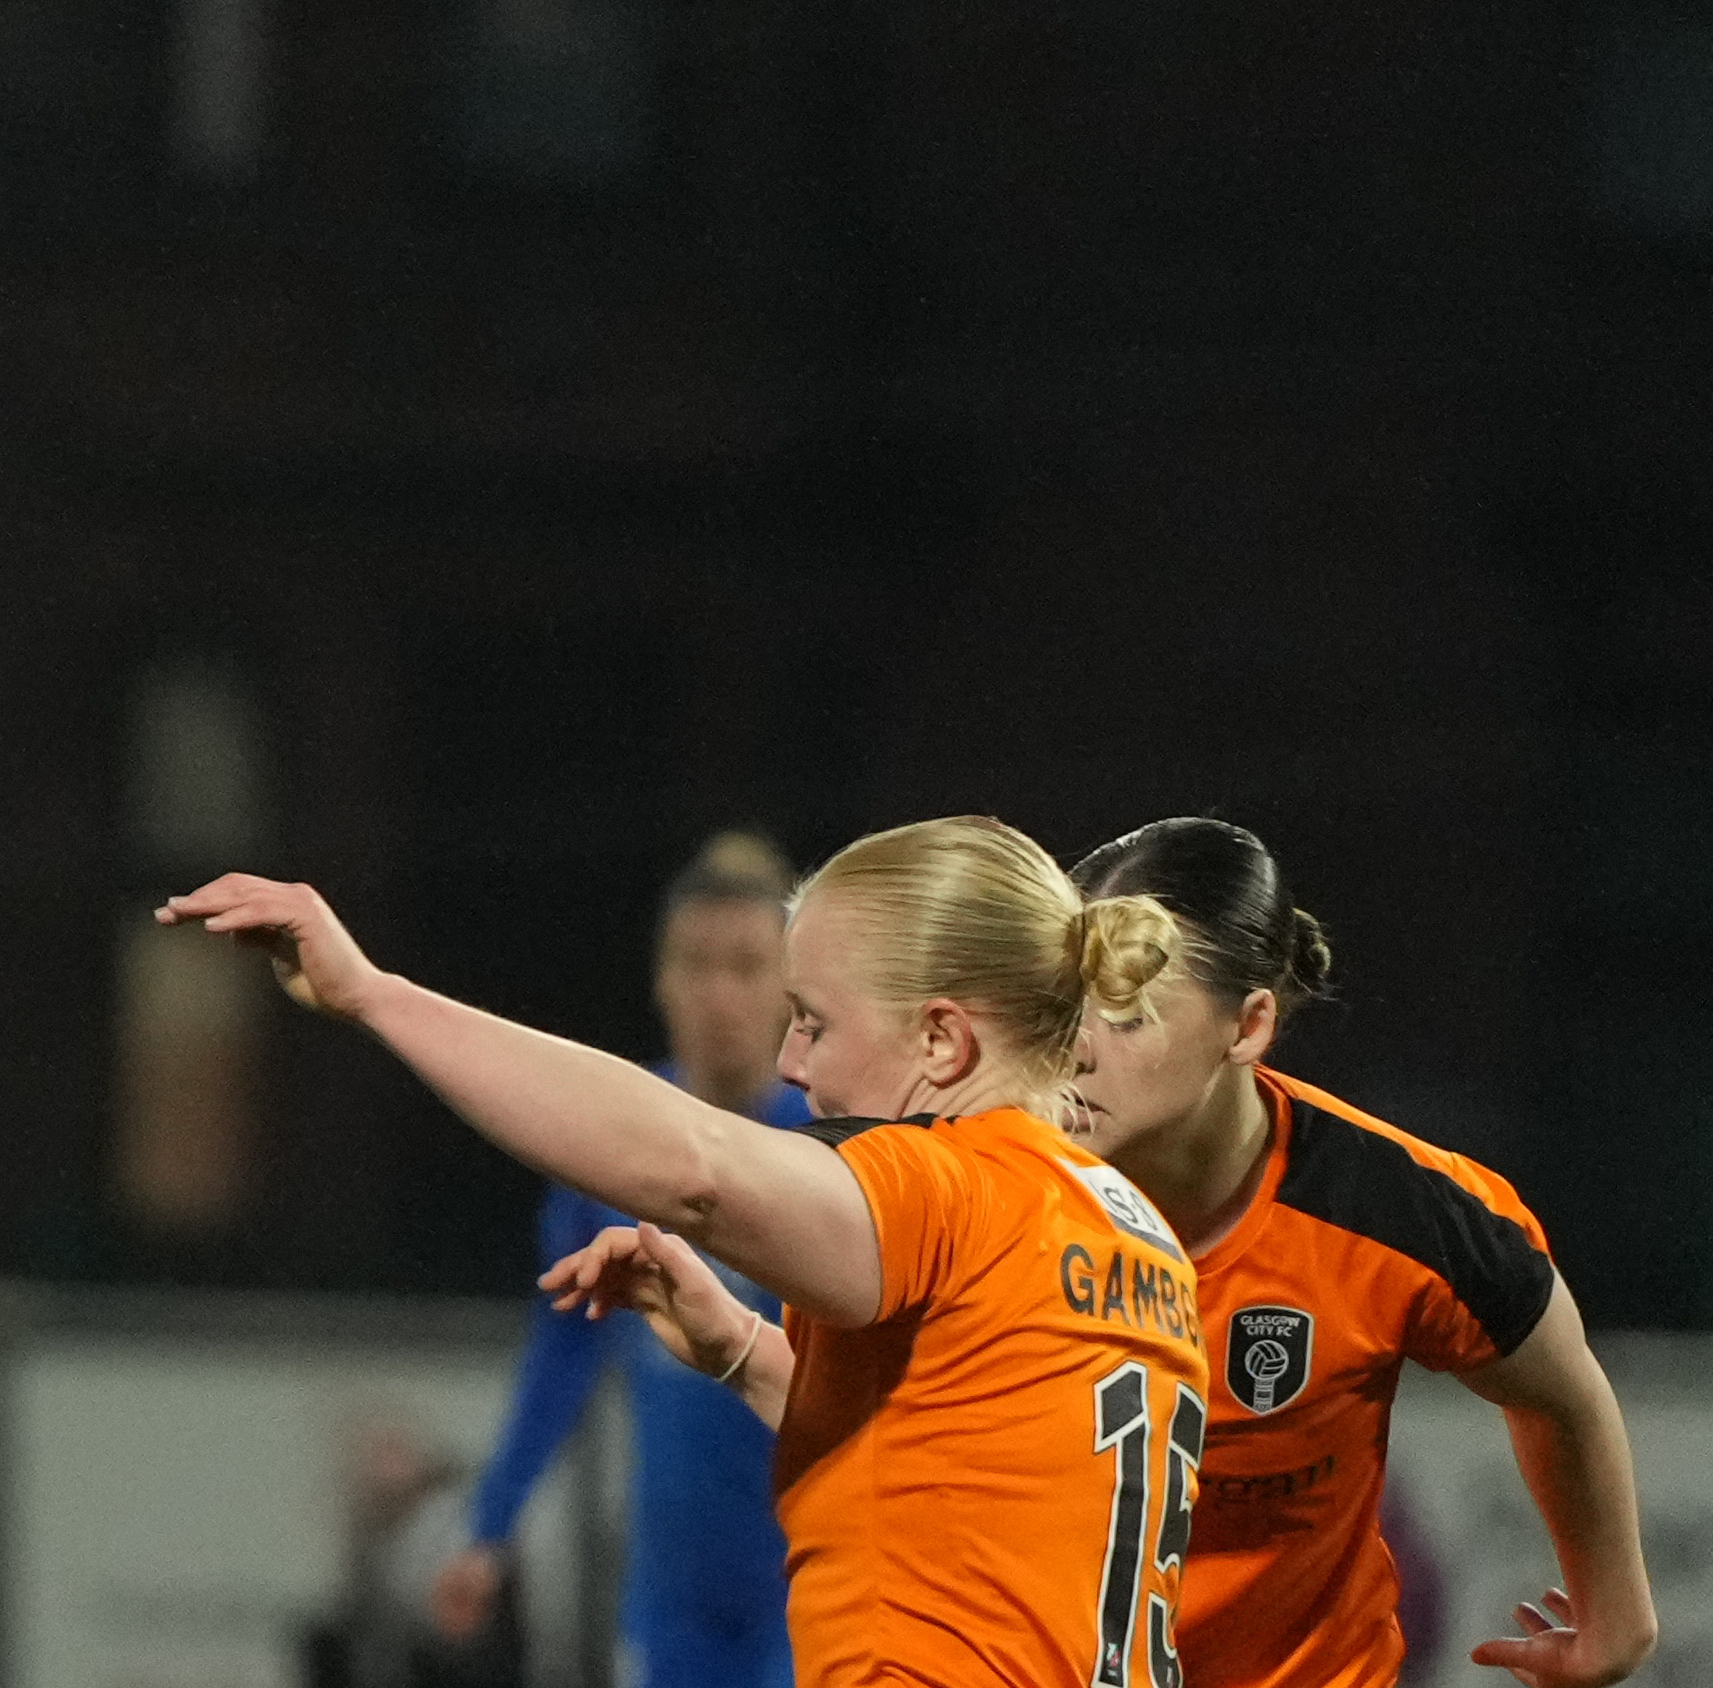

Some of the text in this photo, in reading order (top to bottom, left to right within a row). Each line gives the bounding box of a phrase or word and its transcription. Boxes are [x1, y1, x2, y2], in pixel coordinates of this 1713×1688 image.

[1239, 1314, 1302, 1329] GLASGOW
[1245, 1324, 1293, 1338] CITY FC
